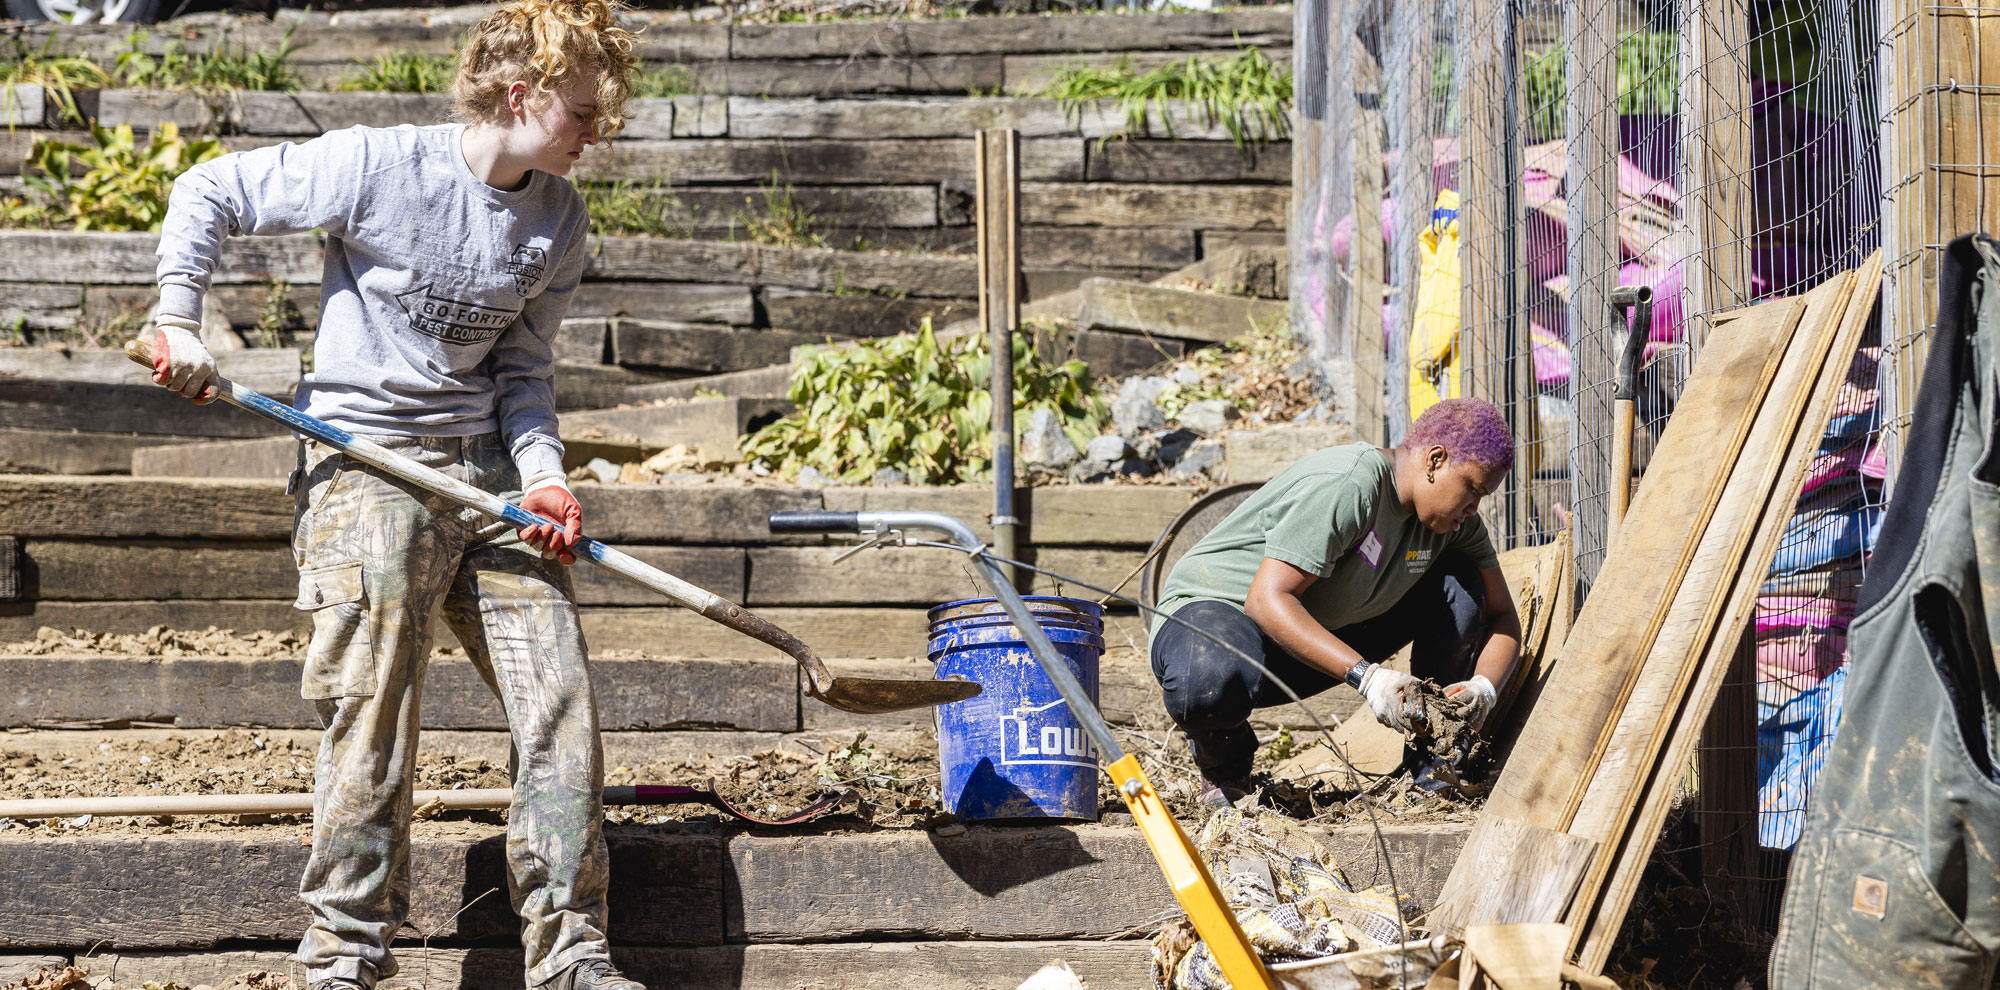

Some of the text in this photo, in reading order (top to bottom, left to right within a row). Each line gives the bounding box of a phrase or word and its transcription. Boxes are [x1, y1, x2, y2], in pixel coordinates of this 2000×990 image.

[508, 264, 542, 278] FUSION
[423, 302, 511, 325] GO-FORTH
[419, 319, 449, 335] PEST
